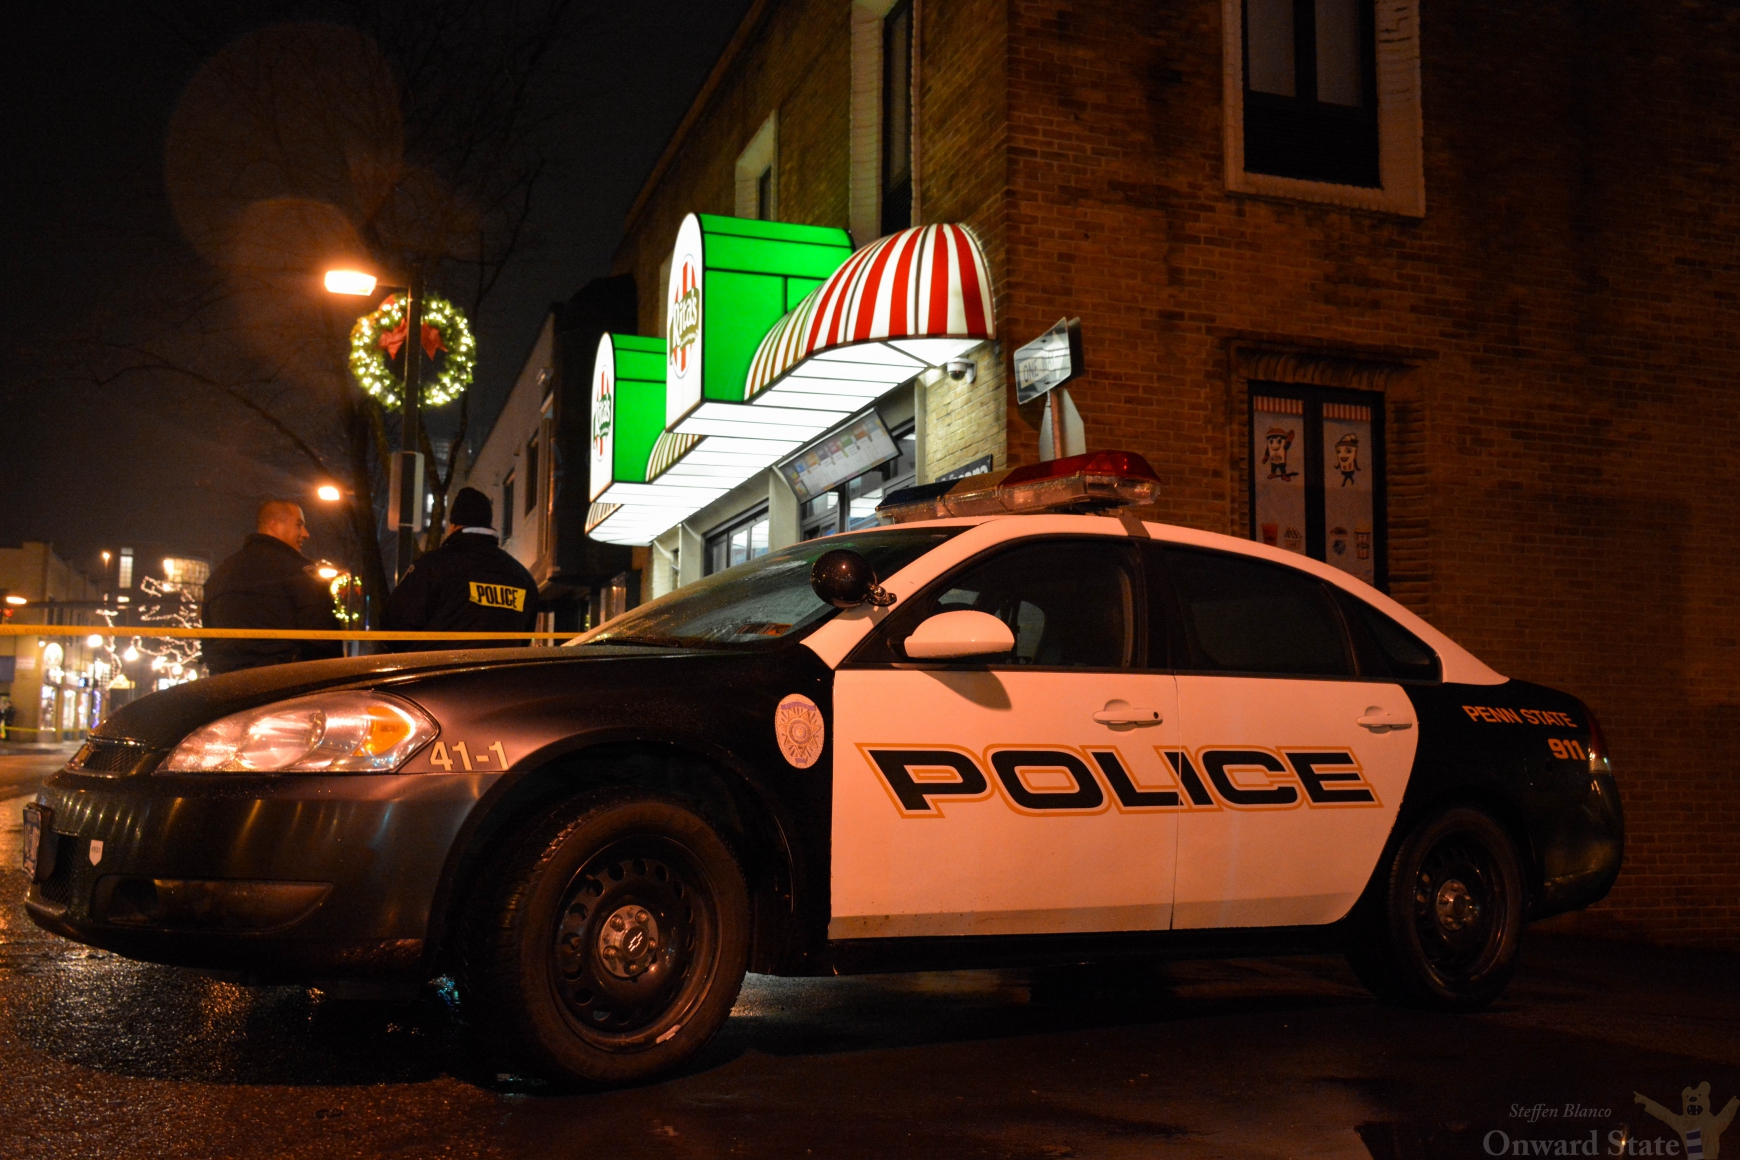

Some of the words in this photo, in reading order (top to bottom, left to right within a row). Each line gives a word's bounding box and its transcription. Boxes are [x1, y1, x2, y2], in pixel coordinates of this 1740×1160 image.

[672, 288, 697, 347] Rita's
[1023, 360, 1039, 382] ONE
[476, 585, 518, 608] POLICE
[1461, 705, 1523, 724] PENN
[1519, 708, 1578, 728] STATE
[430, 741, 509, 771] 41-1
[1547, 737, 1586, 760] 911
[855, 743, 1383, 818] POLICE
